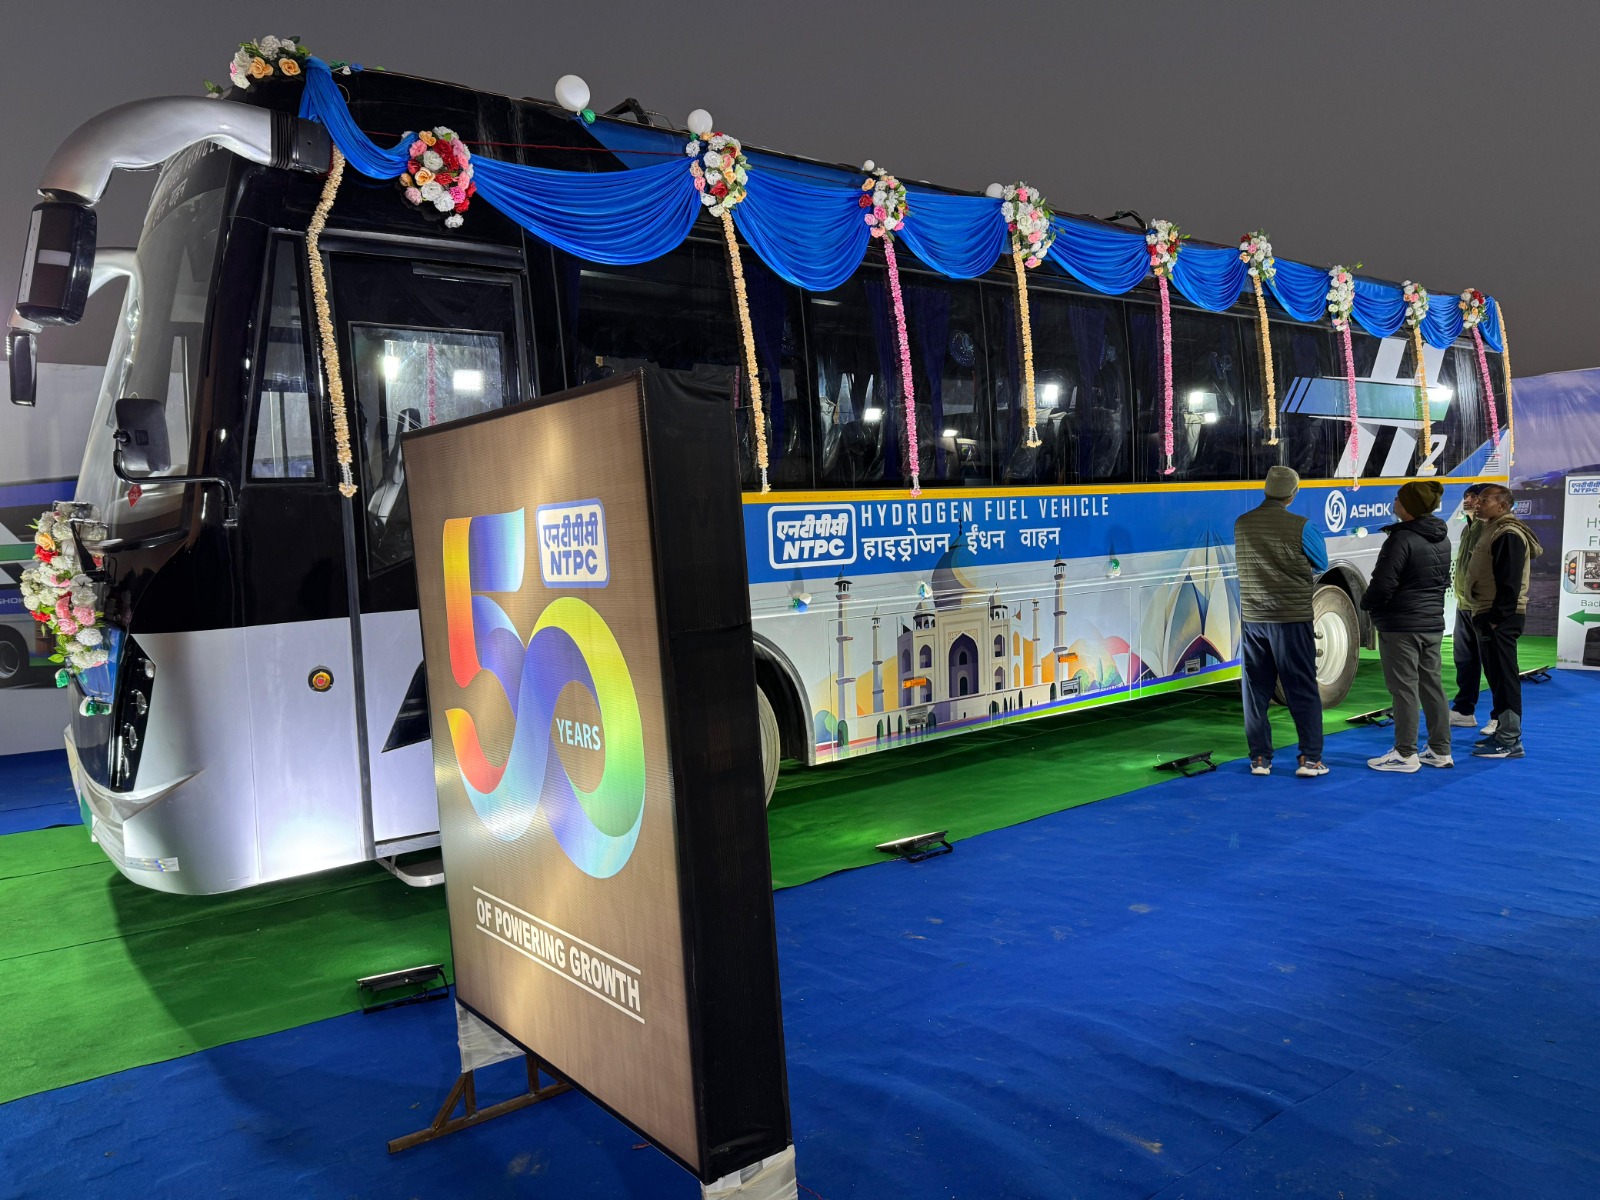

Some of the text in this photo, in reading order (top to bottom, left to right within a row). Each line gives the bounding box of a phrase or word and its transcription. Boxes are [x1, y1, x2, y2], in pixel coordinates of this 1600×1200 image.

[861, 496, 1109, 527] HYDROGEN FUEL VEHICLE
[1349, 502, 1391, 519] ASHOK
[543, 512, 599, 550] एनटीपीसी
[777, 513, 848, 541] एनटीपीसी
[783, 538, 845, 560] NTPC
[861, 524, 1061, 562] हाइड्रोजन ईंधन वाहन
[550, 548, 598, 575] NTPC
[556, 717, 601, 751] YEARS
[476, 897, 641, 1012] OF POWERING GROWTH
